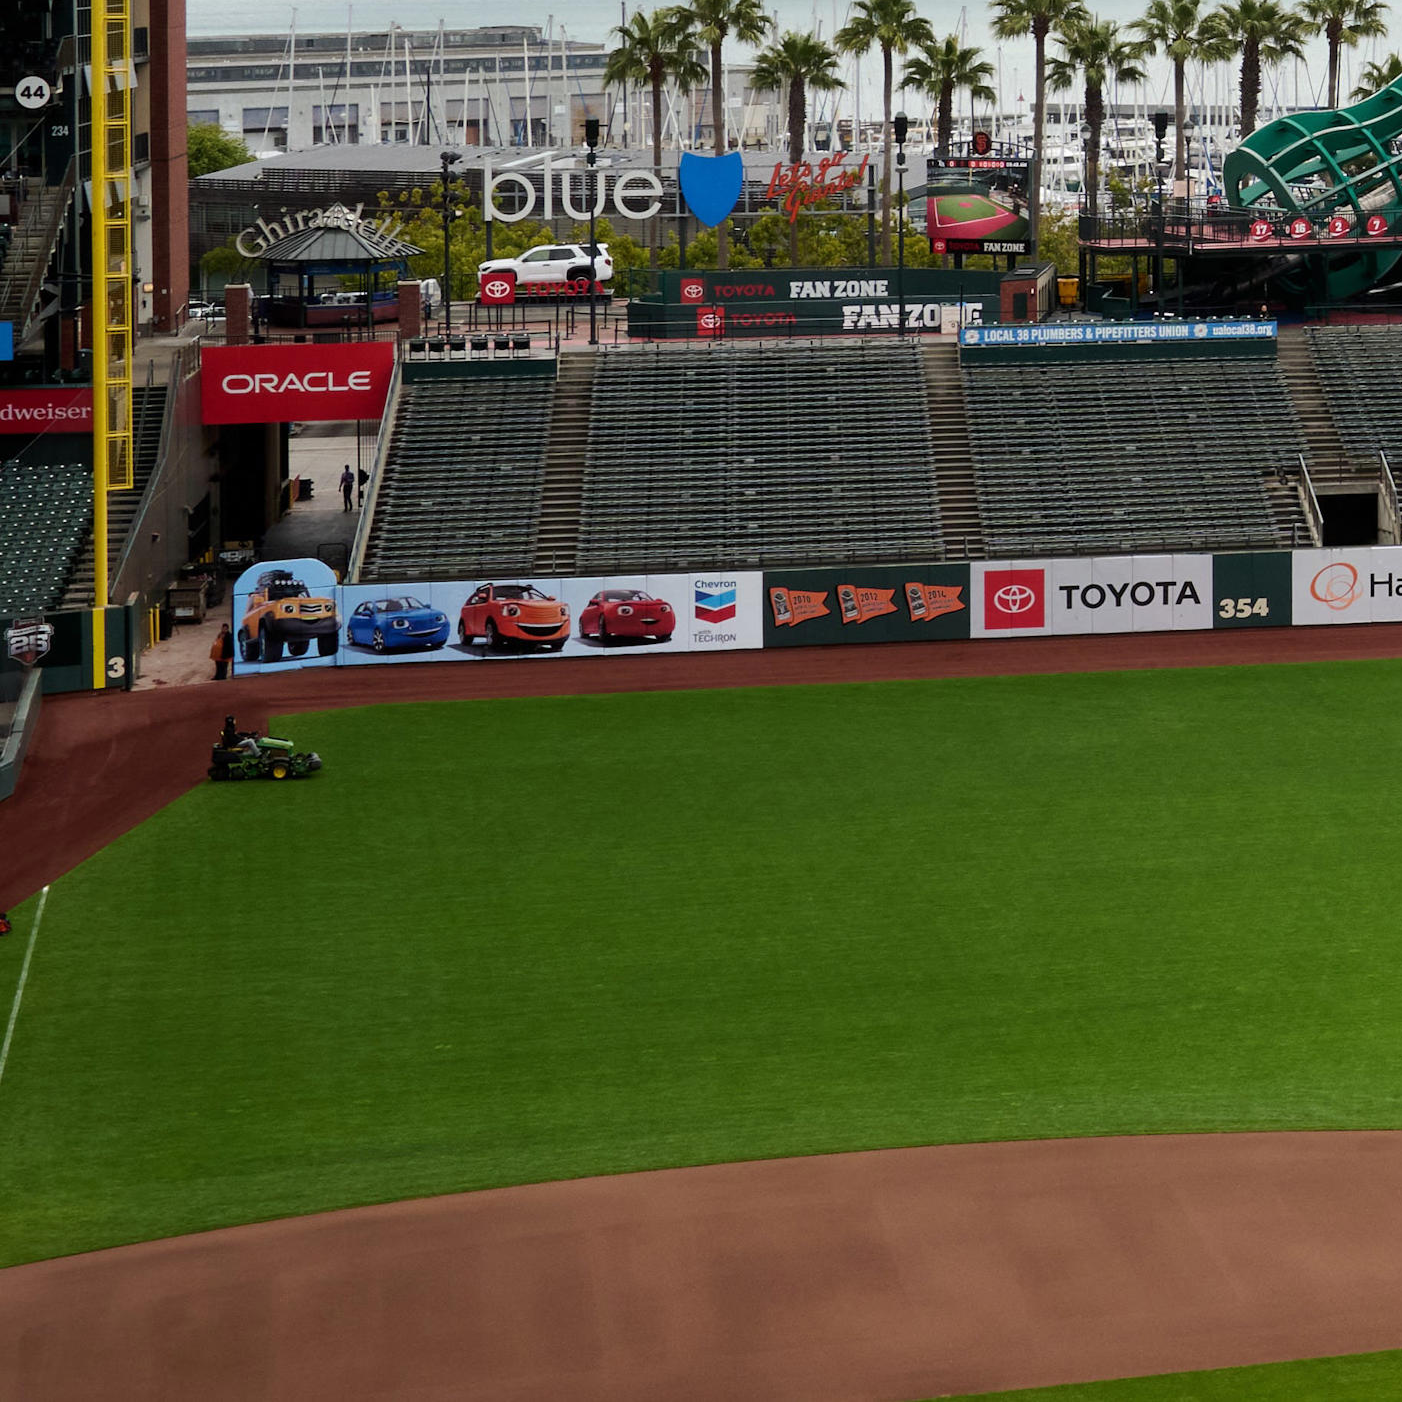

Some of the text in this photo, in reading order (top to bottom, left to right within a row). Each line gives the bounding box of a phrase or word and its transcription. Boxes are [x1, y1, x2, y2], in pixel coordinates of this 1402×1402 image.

[20, 86, 45, 99] 44
[52, 125, 69, 136] 234
[485, 157, 663, 222] blue
[1255, 224, 1267, 234] 17
[1373, 220, 1380, 229] 7
[984, 243, 1001, 252] FAN
[1002, 243, 1025, 252] ZONE
[525, 280, 605, 296] TOYOTA
[713, 280, 888, 298] TOYOTA FAN ZONE
[730, 302, 982, 329] TOYOTA FAN ZOE
[984, 323, 1273, 342] LOCAL 38 PLUMBERS & PIPEFITTERS UNION ualocal38.org
[222, 371, 371, 394] ORACLE
[695, 580, 736, 589] Chevron
[793, 595, 811, 606] 2010
[860, 592, 877, 602] 2012
[928, 589, 946, 600] 2014
[1058, 581, 1200, 610] TOYOTA
[1219, 598, 1269, 619] 354
[693, 633, 736, 644] TECHRON
[107, 657, 125, 678] 3
